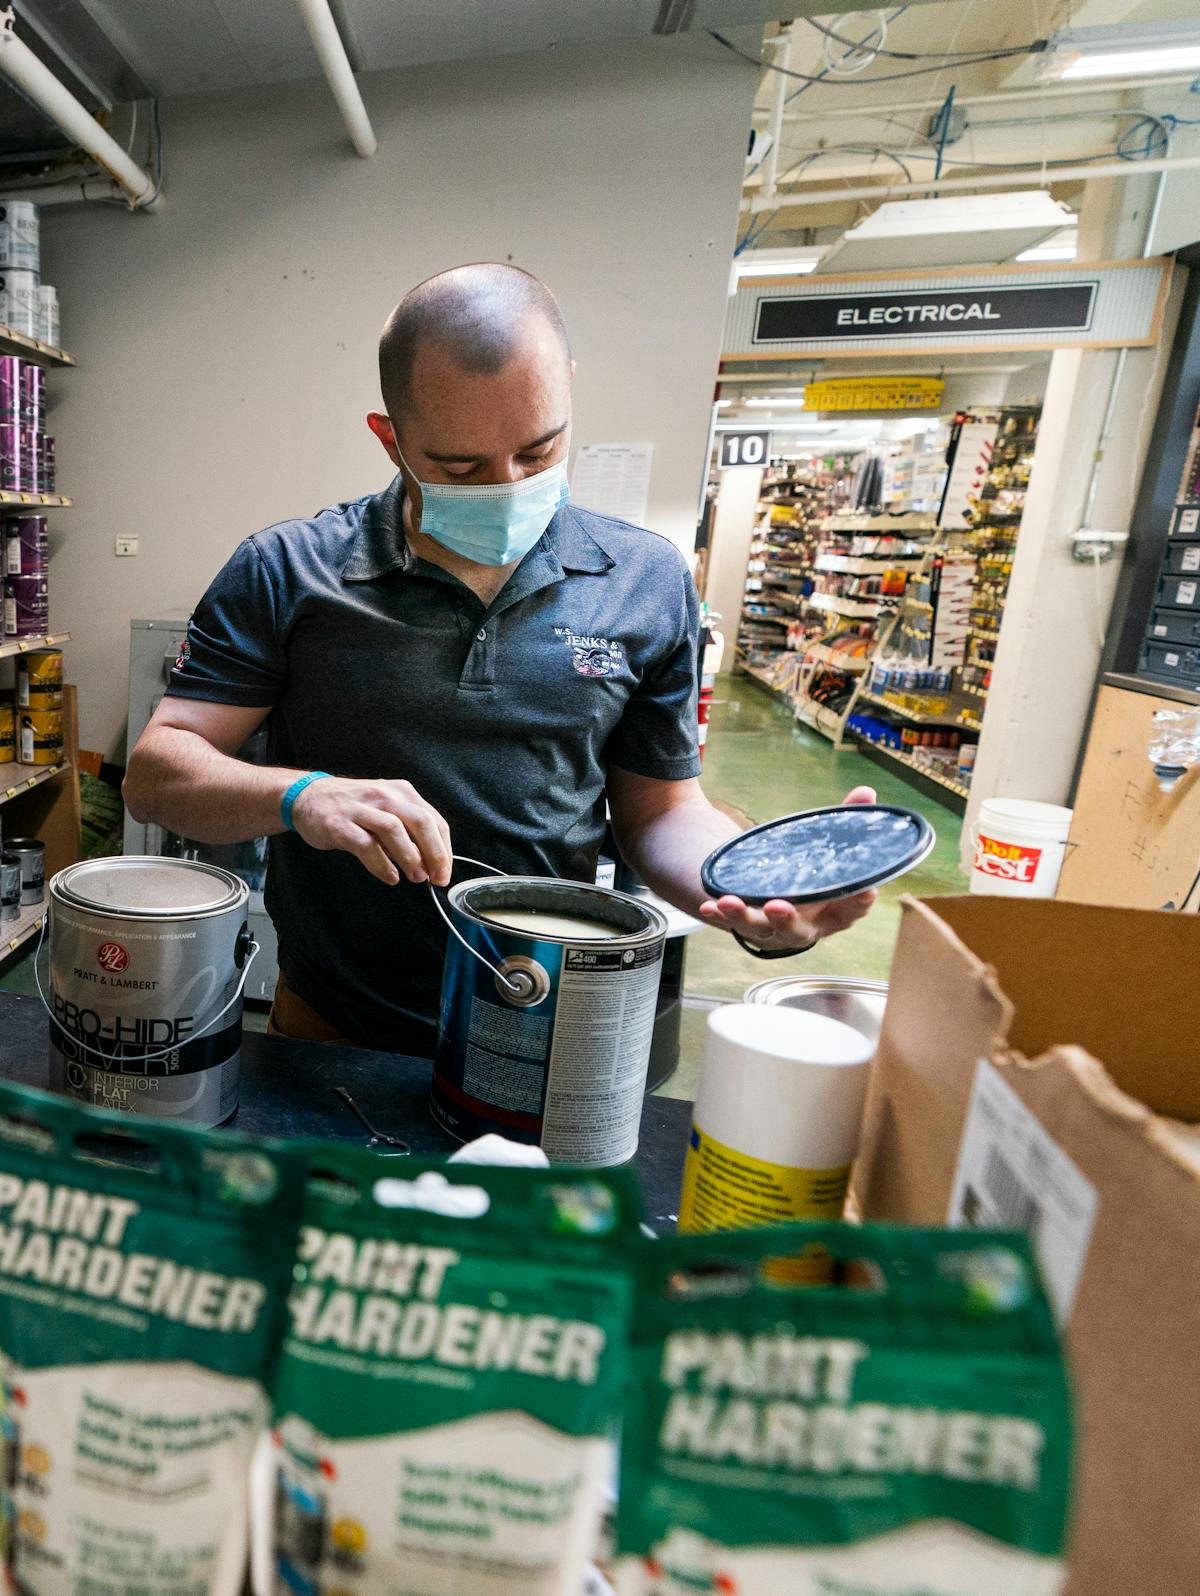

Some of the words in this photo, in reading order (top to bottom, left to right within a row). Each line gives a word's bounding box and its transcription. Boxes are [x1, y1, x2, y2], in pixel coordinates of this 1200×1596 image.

[837, 302, 1001, 325] ELECTRICAL
[727, 435, 764, 464] 10
[554, 627, 574, 636] W.S.
[565, 635, 608, 649] JENKS
[610, 641, 618, 650] &
[583, 955, 597, 965] 400
[74, 967, 98, 984] PRATT
[101, 976, 108, 986] &
[110, 976, 158, 991] LAMBERT
[55, 993, 194, 1044] PRO-HIDE
[62, 1026, 169, 1076] SILVER
[94, 1071, 159, 1092] INTERIOR
[94, 1083, 130, 1101] FLAT
[94, 1099, 137, 1115] LATEX
[661, 1328, 870, 1404] PAINT
[658, 1391, 1045, 1494] HARDENER
